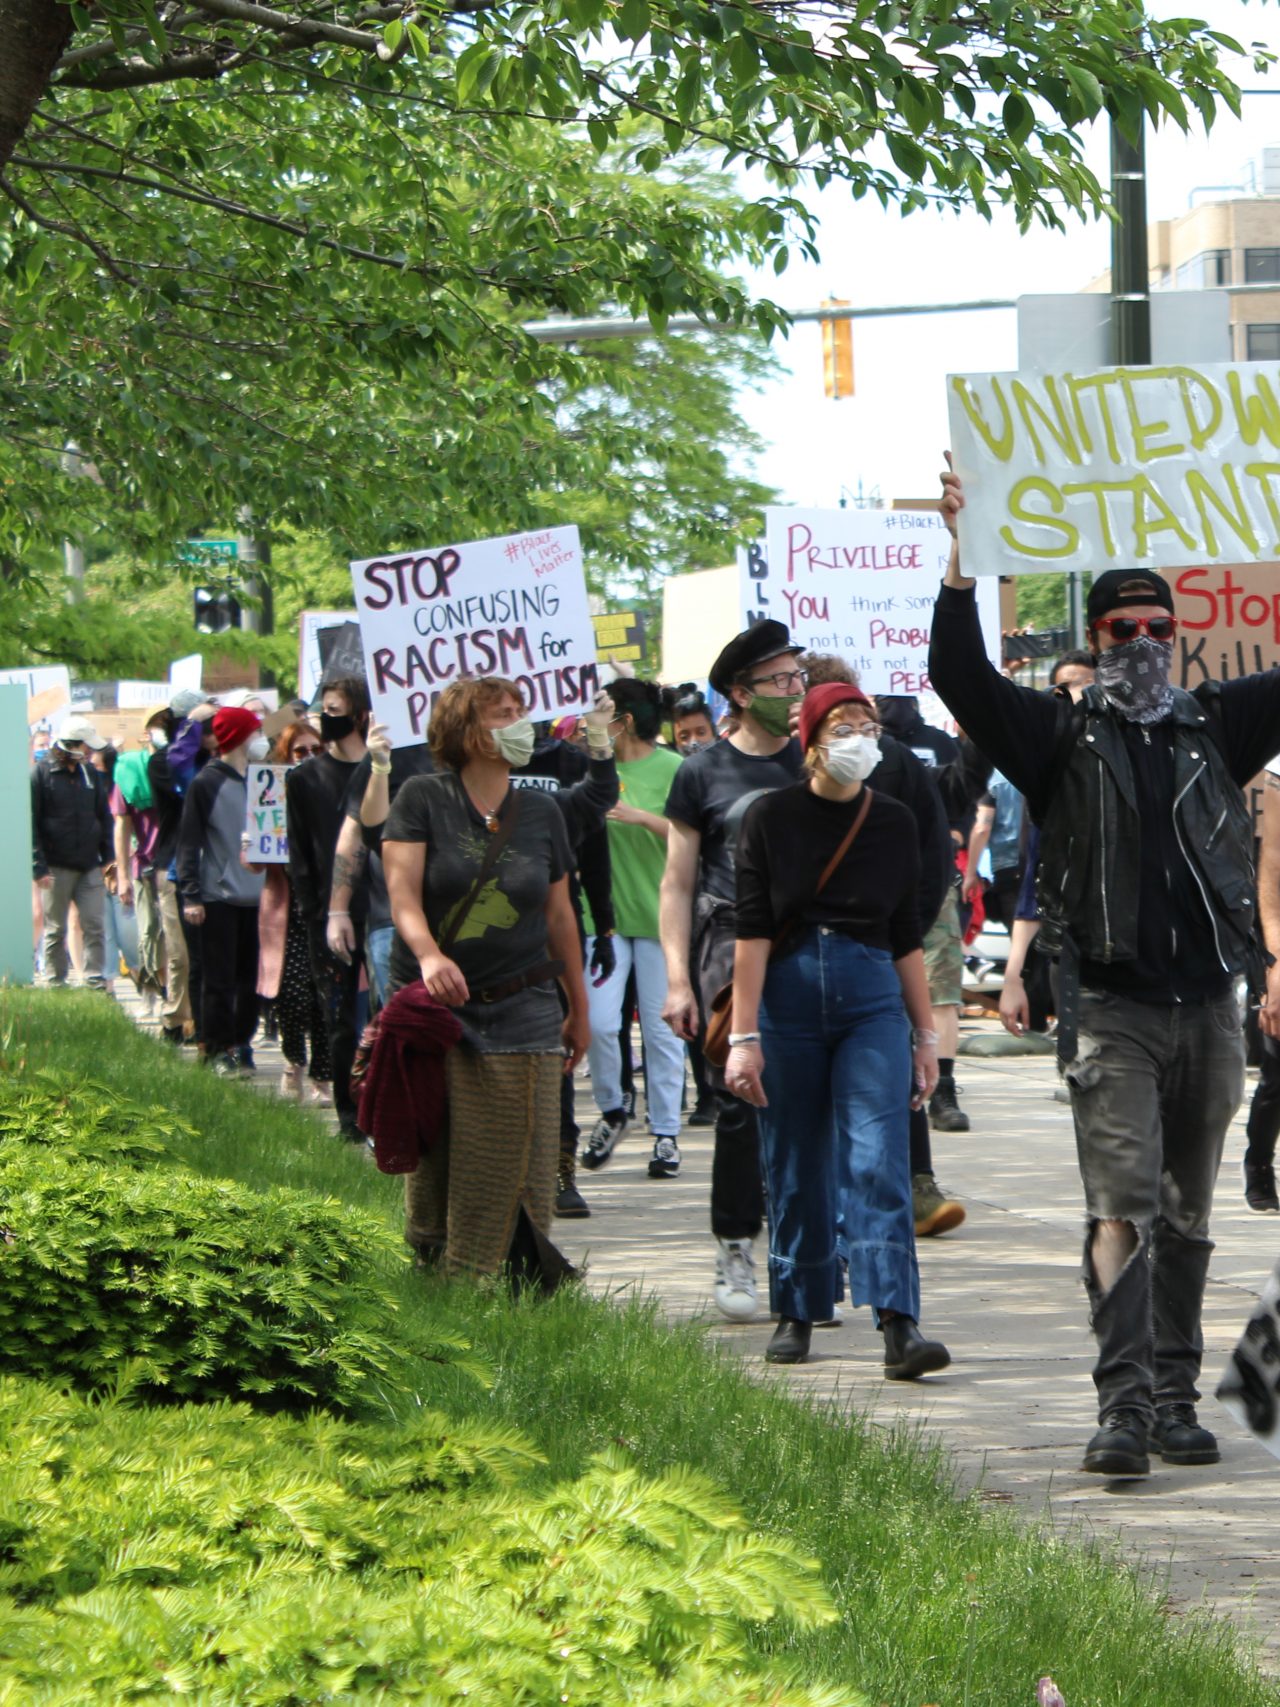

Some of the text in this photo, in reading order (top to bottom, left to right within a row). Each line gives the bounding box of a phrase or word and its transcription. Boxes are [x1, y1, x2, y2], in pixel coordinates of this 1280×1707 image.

[952, 365, 1222, 465] UNITED
[364, 549, 461, 611] STOP
[787, 523, 924, 582] PRIVILEGE
[414, 584, 560, 637] CONFUSING
[781, 589, 830, 629] YOU
[373, 626, 535, 694] RACISM
[539, 632, 574, 662] for
[809, 633, 838, 649] not
[884, 656, 909, 670] not
